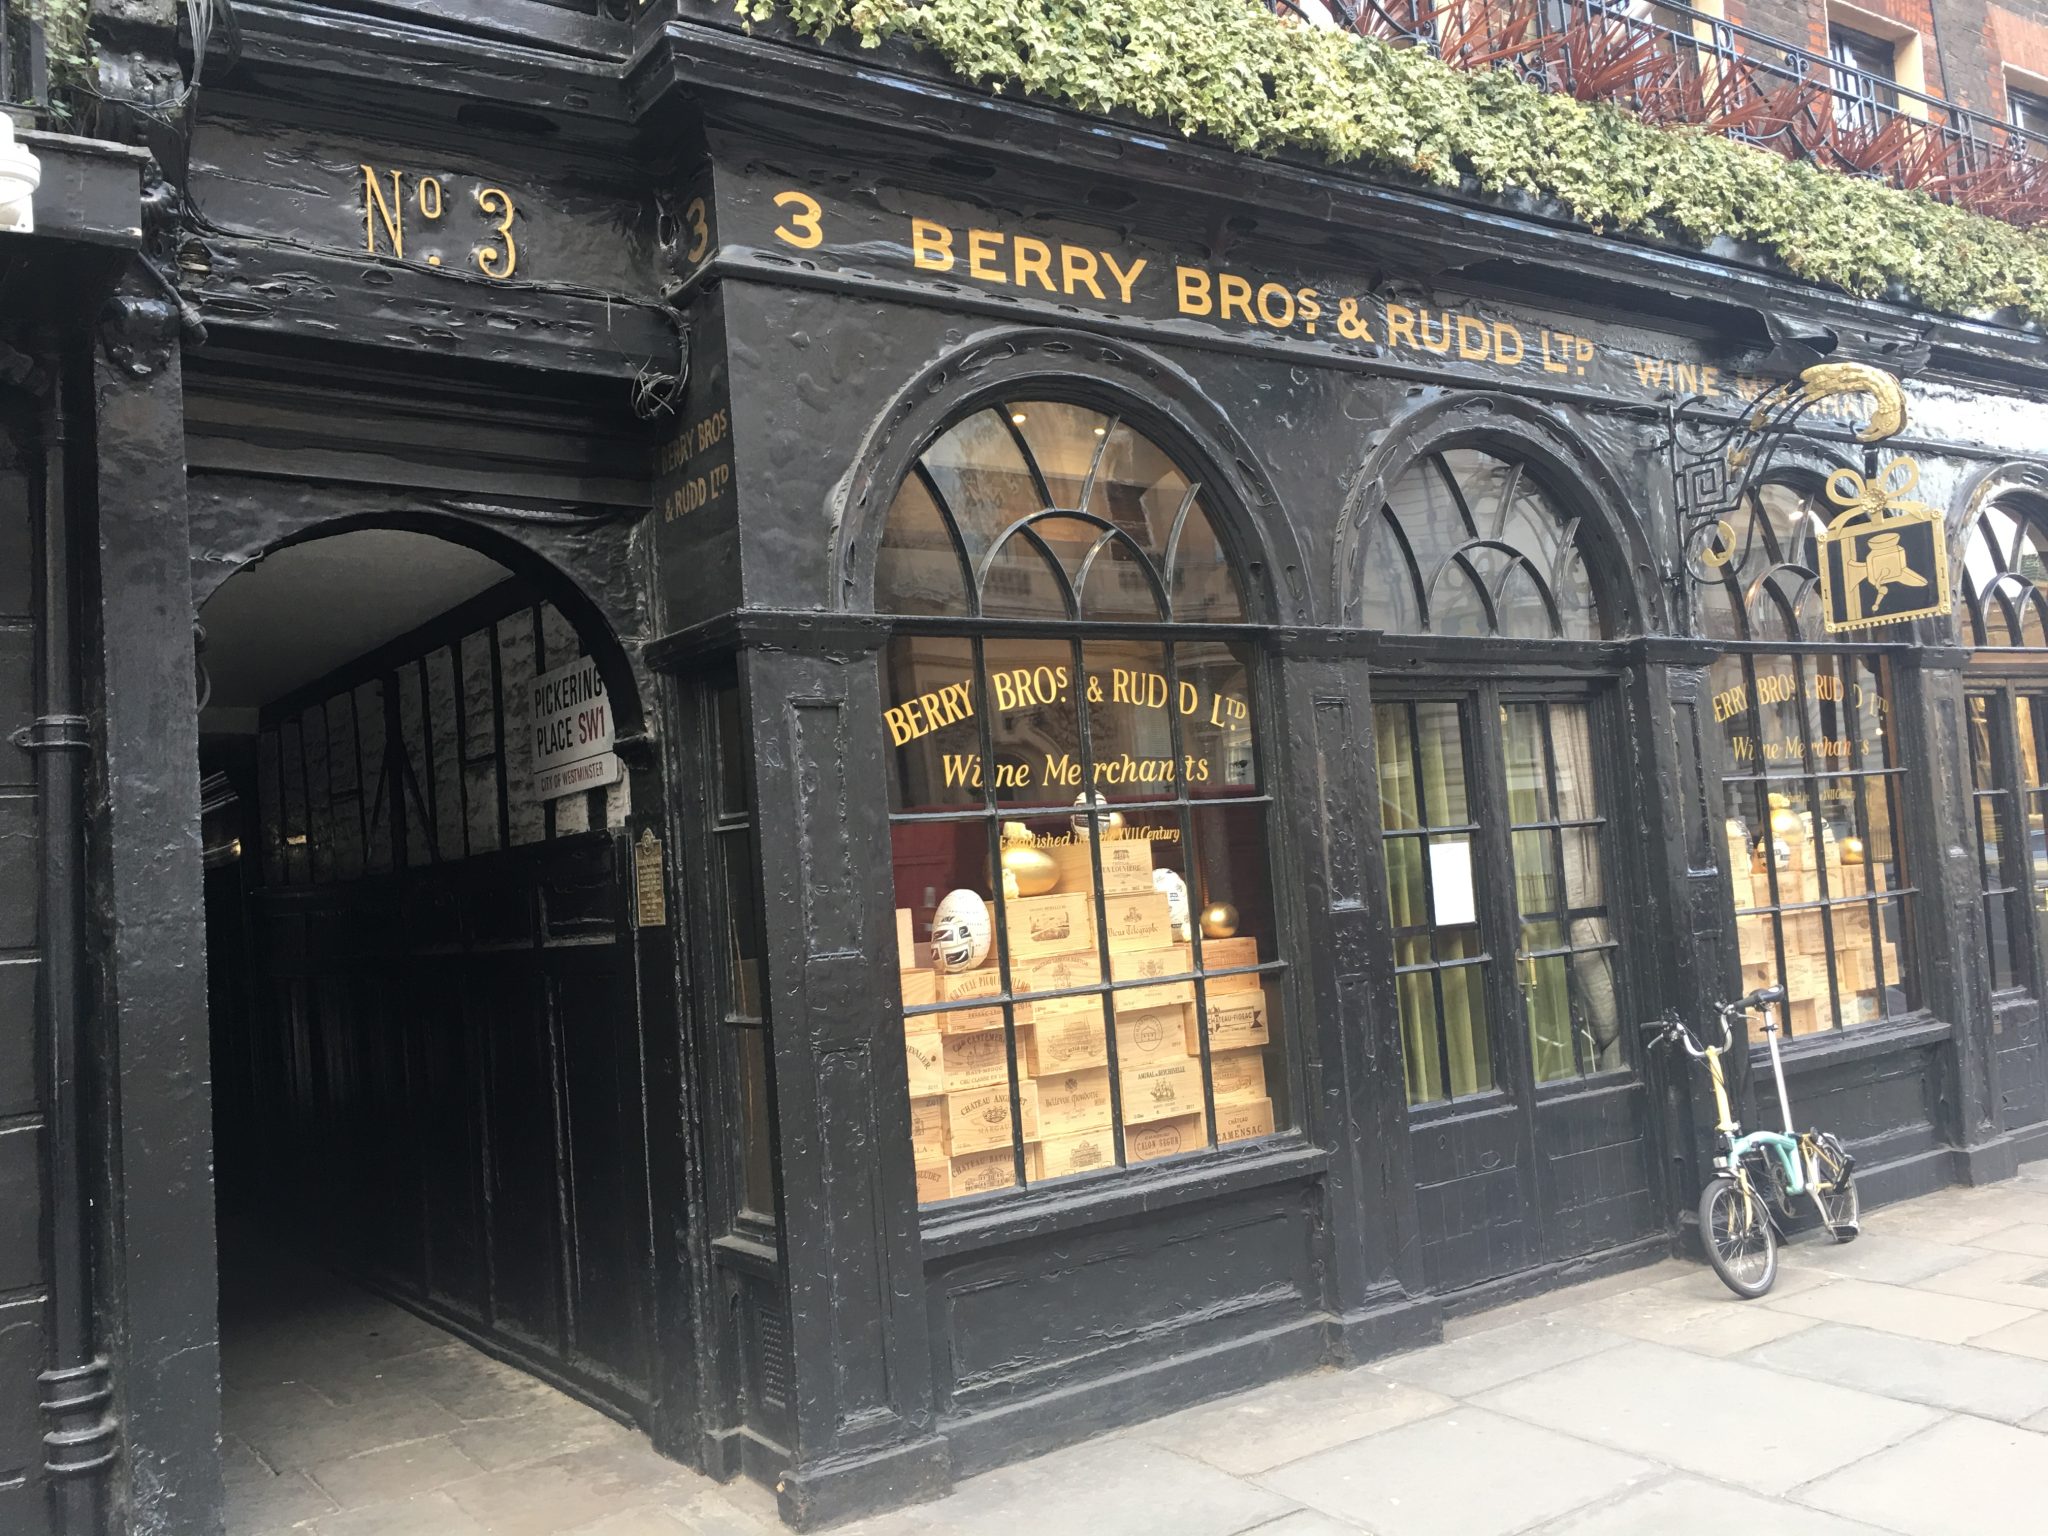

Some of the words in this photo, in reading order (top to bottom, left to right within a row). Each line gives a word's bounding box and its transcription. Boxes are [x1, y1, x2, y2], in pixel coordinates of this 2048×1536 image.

[477, 187, 517, 279] 3
[686, 196, 709, 263] 3
[773, 191, 823, 249] 3
[911, 216, 1147, 304] BERRY
[1337, 297, 1374, 343] &
[1387, 302, 1525, 367] RUDD
[1634, 354, 1721, 397] WINE
[662, 428, 694, 476] BERRY
[665, 497, 675, 523] &
[674, 477, 707, 519] RUDD
[534, 666, 603, 719] PICKERING
[883, 679, 974, 747] BERRY
[1087, 676, 1103, 703] &
[1112, 668, 1198, 715] RUDD
[1713, 684, 1748, 722] ERRY
[536, 717, 574, 758] PLACE
[578, 705, 605, 745] SW1
[1785, 734, 1869, 760] Merchans
[541, 776, 554, 792] CITY
[554, 773, 561, 787] OF
[562, 761, 604, 785] WESTMINSTER
[942, 754, 1031, 788] Wine
[1043, 753, 1209, 787] Merchants
[1141, 825, 1180, 842] Century
